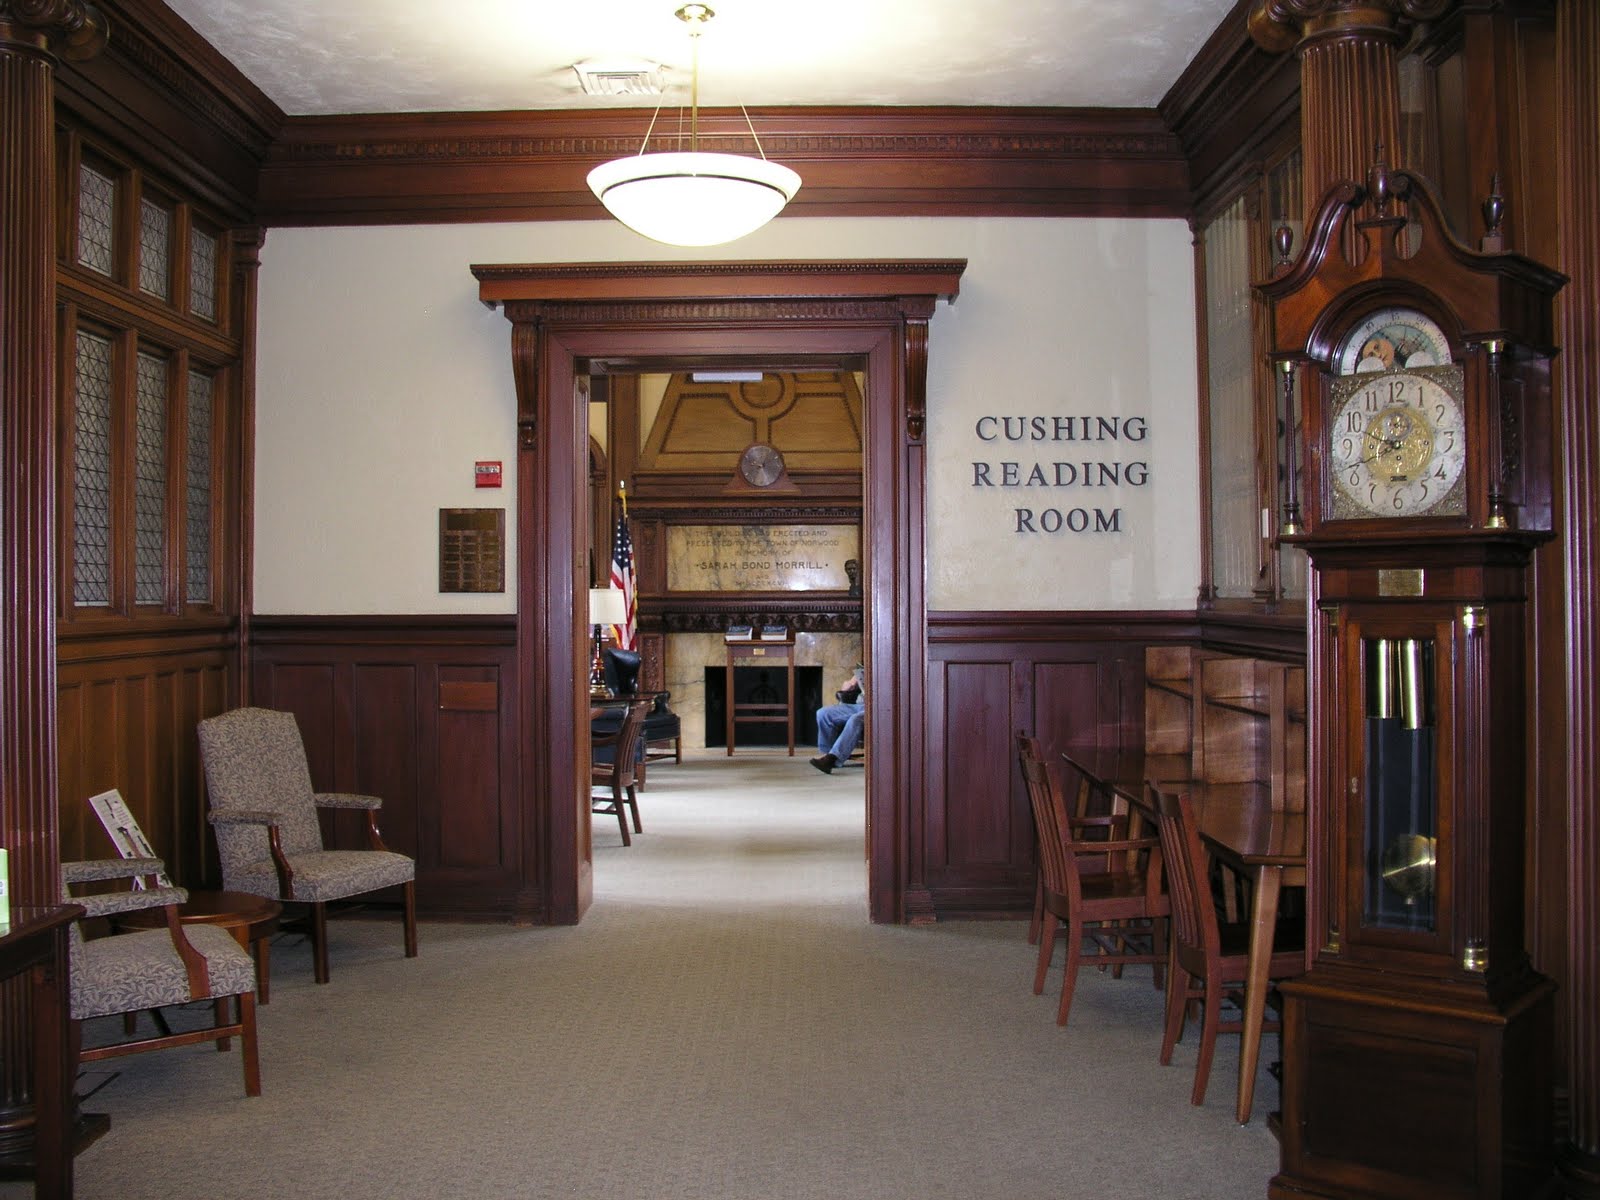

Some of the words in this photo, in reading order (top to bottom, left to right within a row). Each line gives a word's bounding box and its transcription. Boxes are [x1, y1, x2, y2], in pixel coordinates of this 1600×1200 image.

[1364, 390, 1379, 412] 11
[1388, 380, 1406, 403] 12
[1417, 386, 1425, 408] 1
[1346, 411, 1362, 433] 10
[1435, 404, 1445, 426] 2
[975, 416, 1148, 441] CUSHING
[1342, 438, 1353, 460] 9
[1443, 431, 1455, 453] 3
[971, 461, 1149, 487] READING
[1349, 464, 1360, 486] 8
[1434, 463, 1447, 480] 4
[1369, 483, 1377, 503] 7
[1393, 488, 1404, 510] 6
[1419, 478, 1429, 502] 5
[1014, 508, 1122, 533] ROOM
[700, 561, 737, 569] SARAH
[742, 561, 771, 569] BOND
[775, 561, 823, 569] MORRILL
